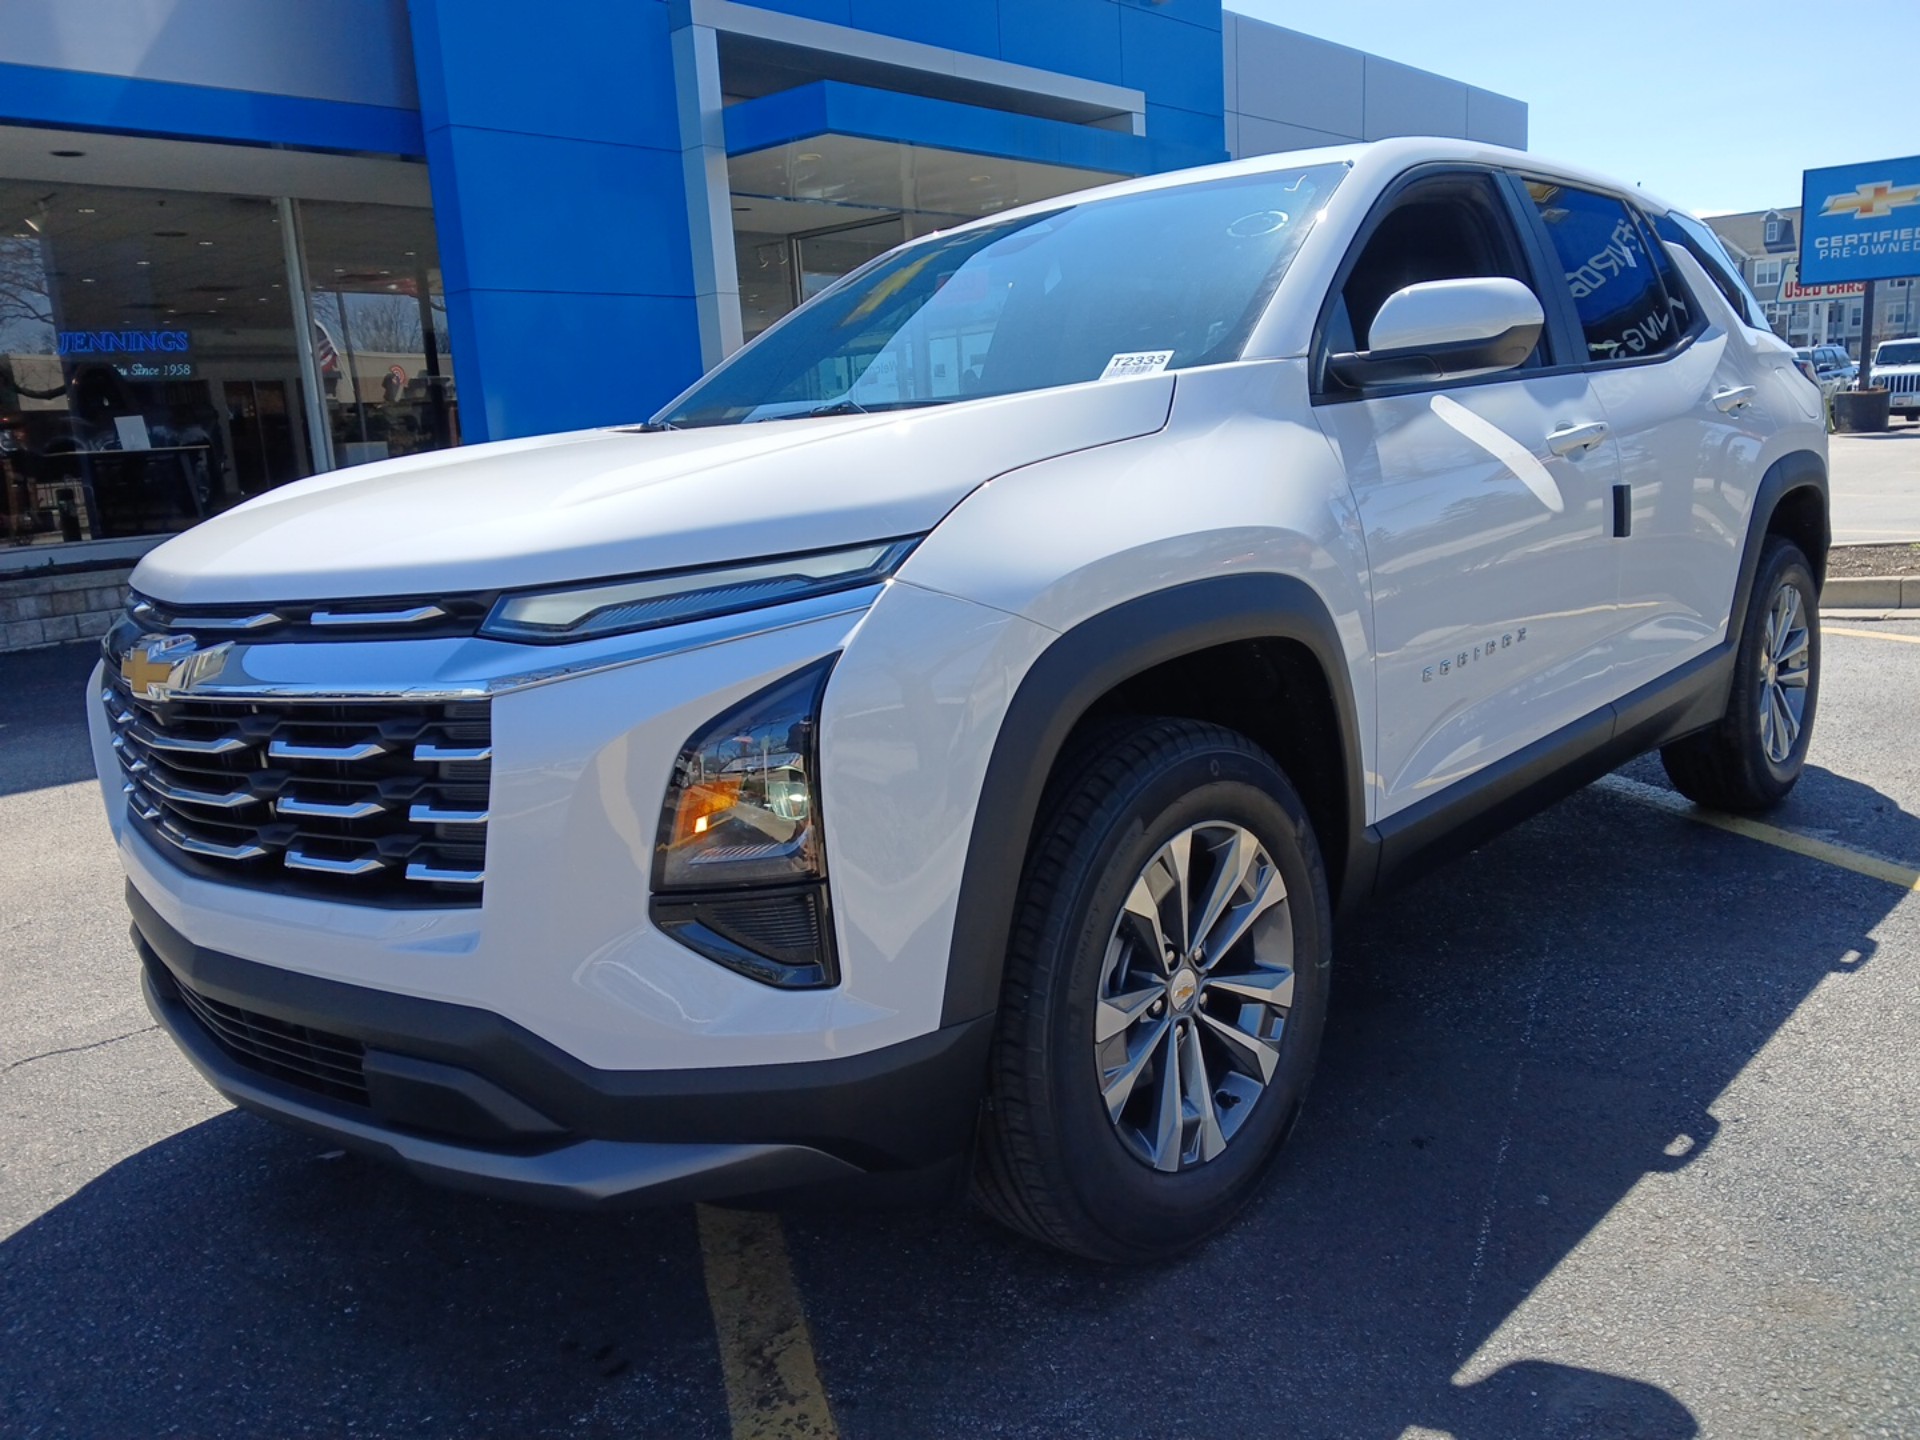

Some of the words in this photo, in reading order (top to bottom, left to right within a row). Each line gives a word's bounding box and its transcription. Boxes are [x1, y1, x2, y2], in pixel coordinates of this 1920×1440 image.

[1819, 239, 1920, 260] PRE-OWNED
[1785, 281, 1822, 298] USED
[59, 331, 188, 354] JENNINGS
[1113, 354, 1167, 367] T2333
[131, 363, 160, 376] Since
[163, 363, 191, 376] 1958
